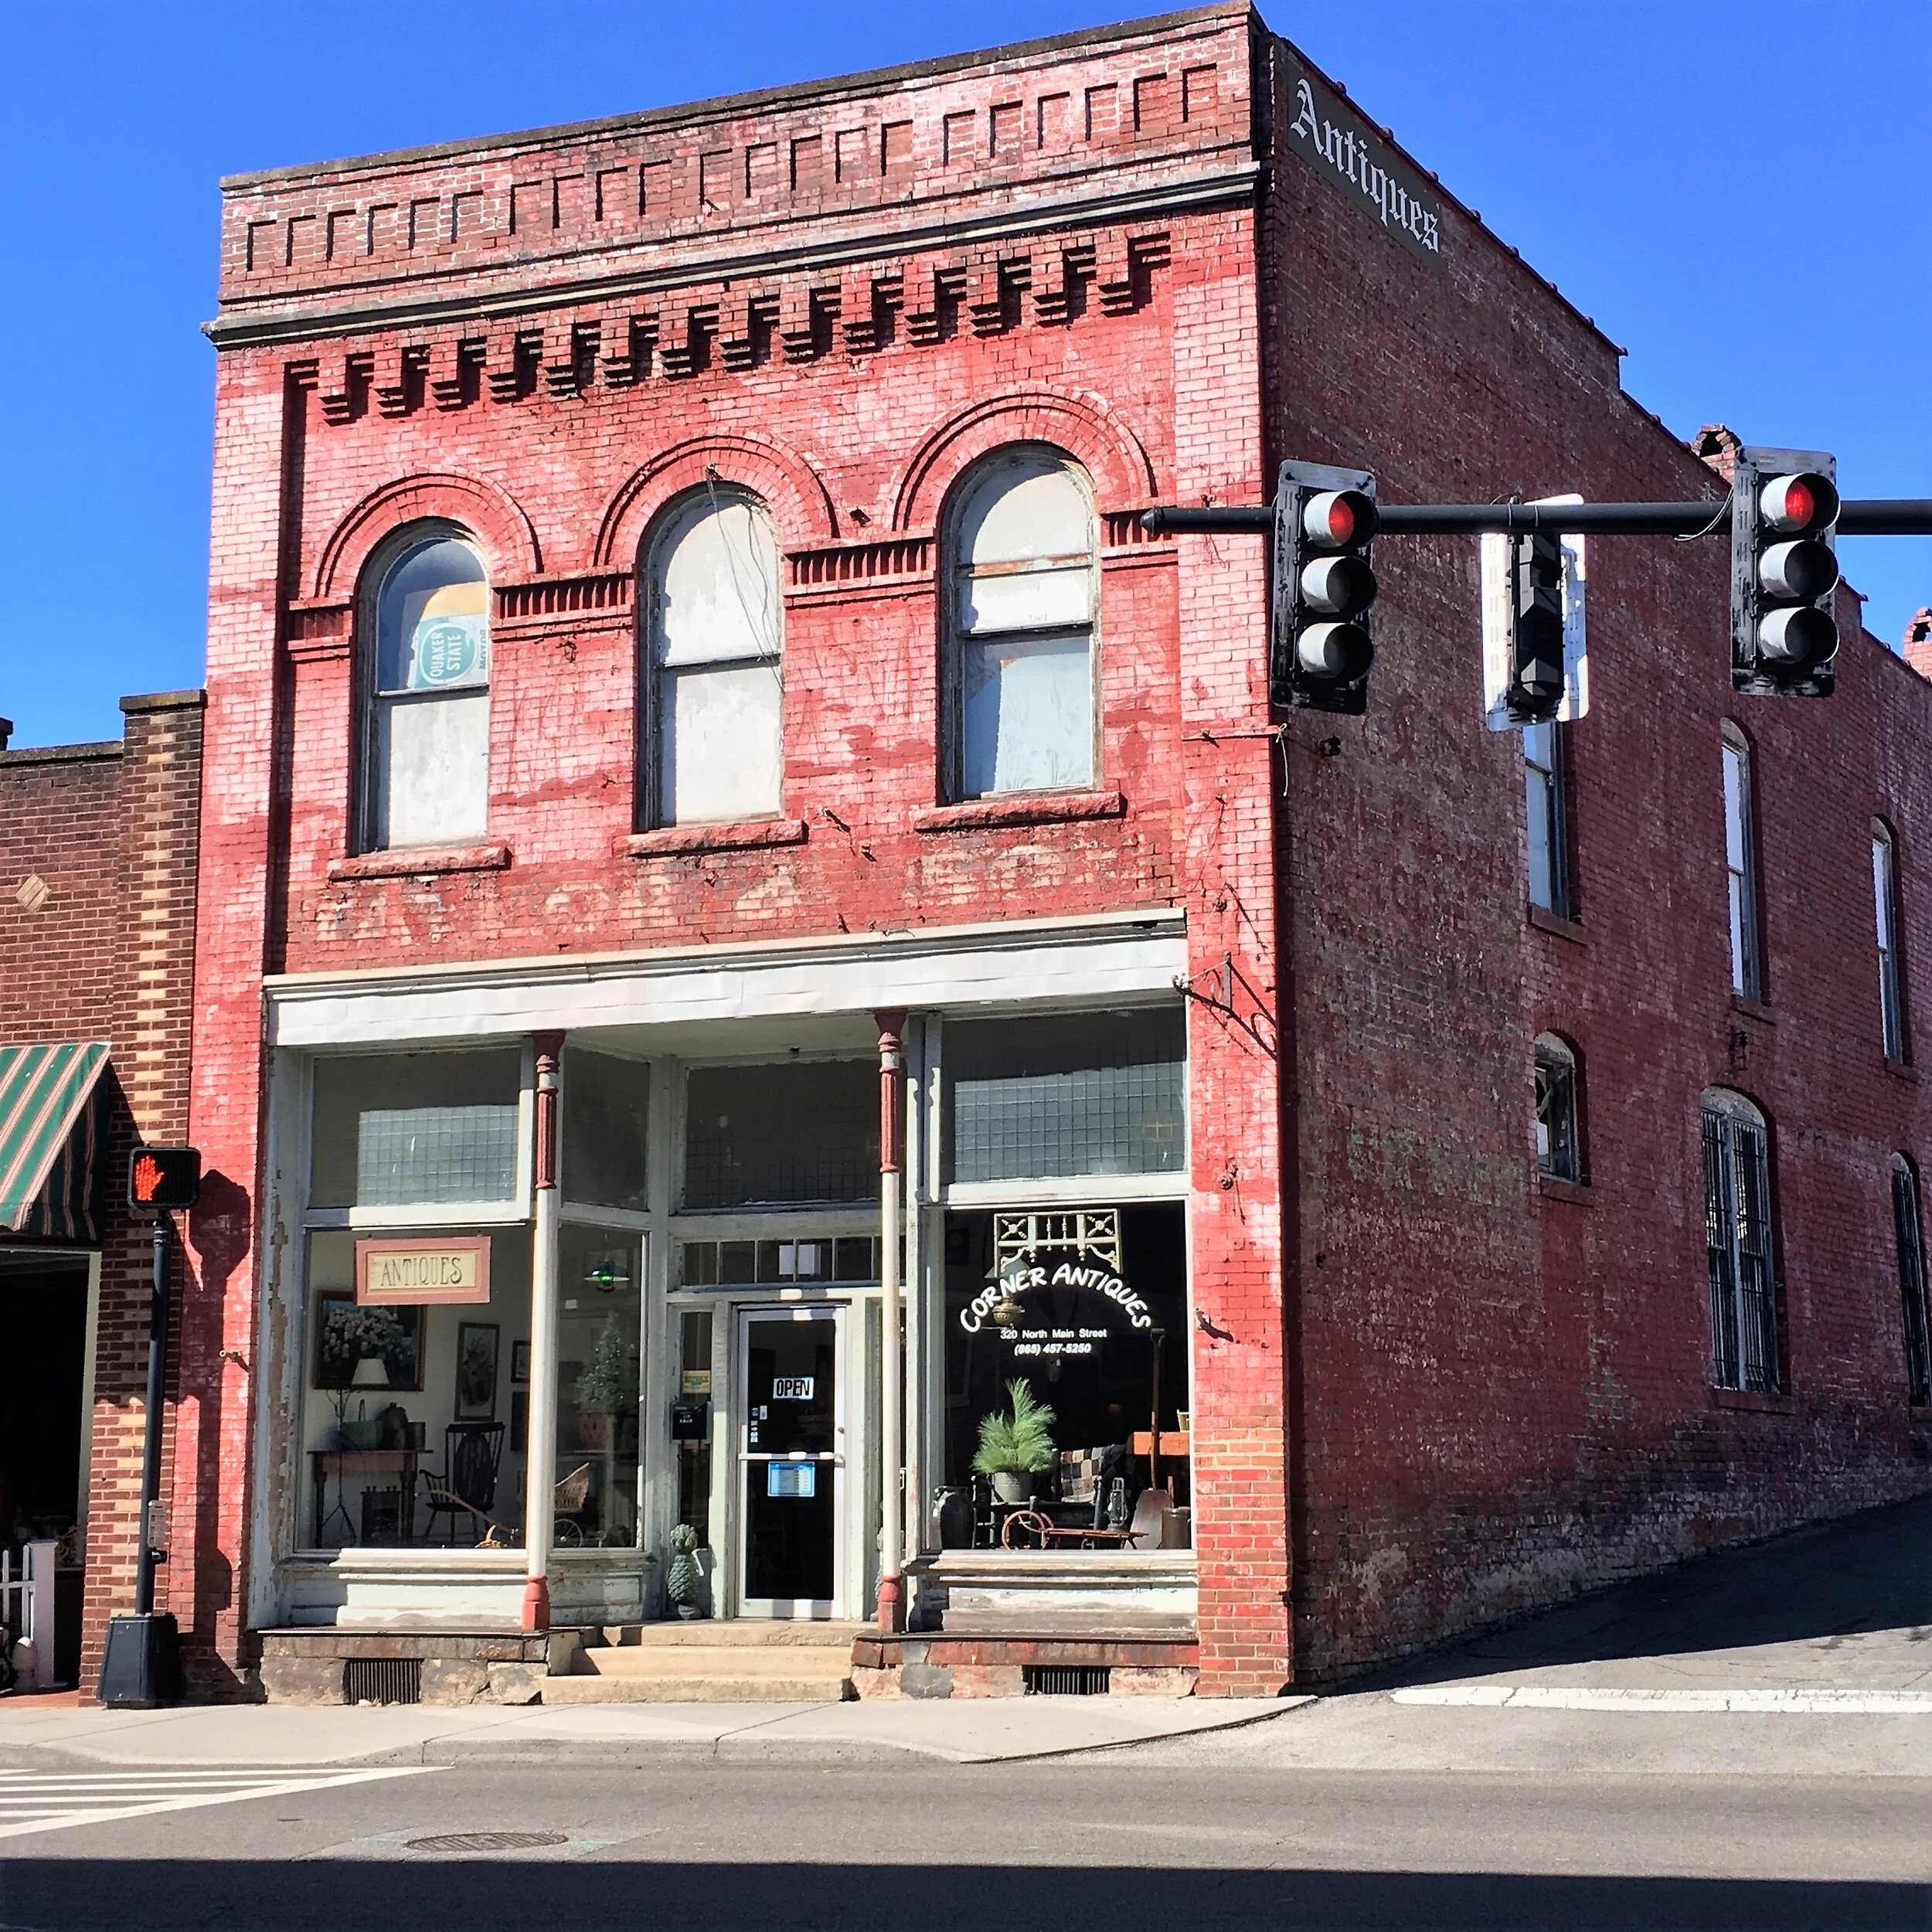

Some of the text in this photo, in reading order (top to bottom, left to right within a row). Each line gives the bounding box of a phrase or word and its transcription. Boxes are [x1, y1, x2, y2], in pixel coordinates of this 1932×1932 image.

[1291, 78, 1439, 253] Antiques
[430, 631, 445, 677] QUAKER
[447, 634, 461, 671] STATE
[380, 1257, 462, 1287] ANTIQUES
[960, 1263, 1151, 1332] CORNER ANTIQUES
[1000, 1328, 1107, 1339] 320 North Main Street
[775, 1379, 810, 1396] OPEN
